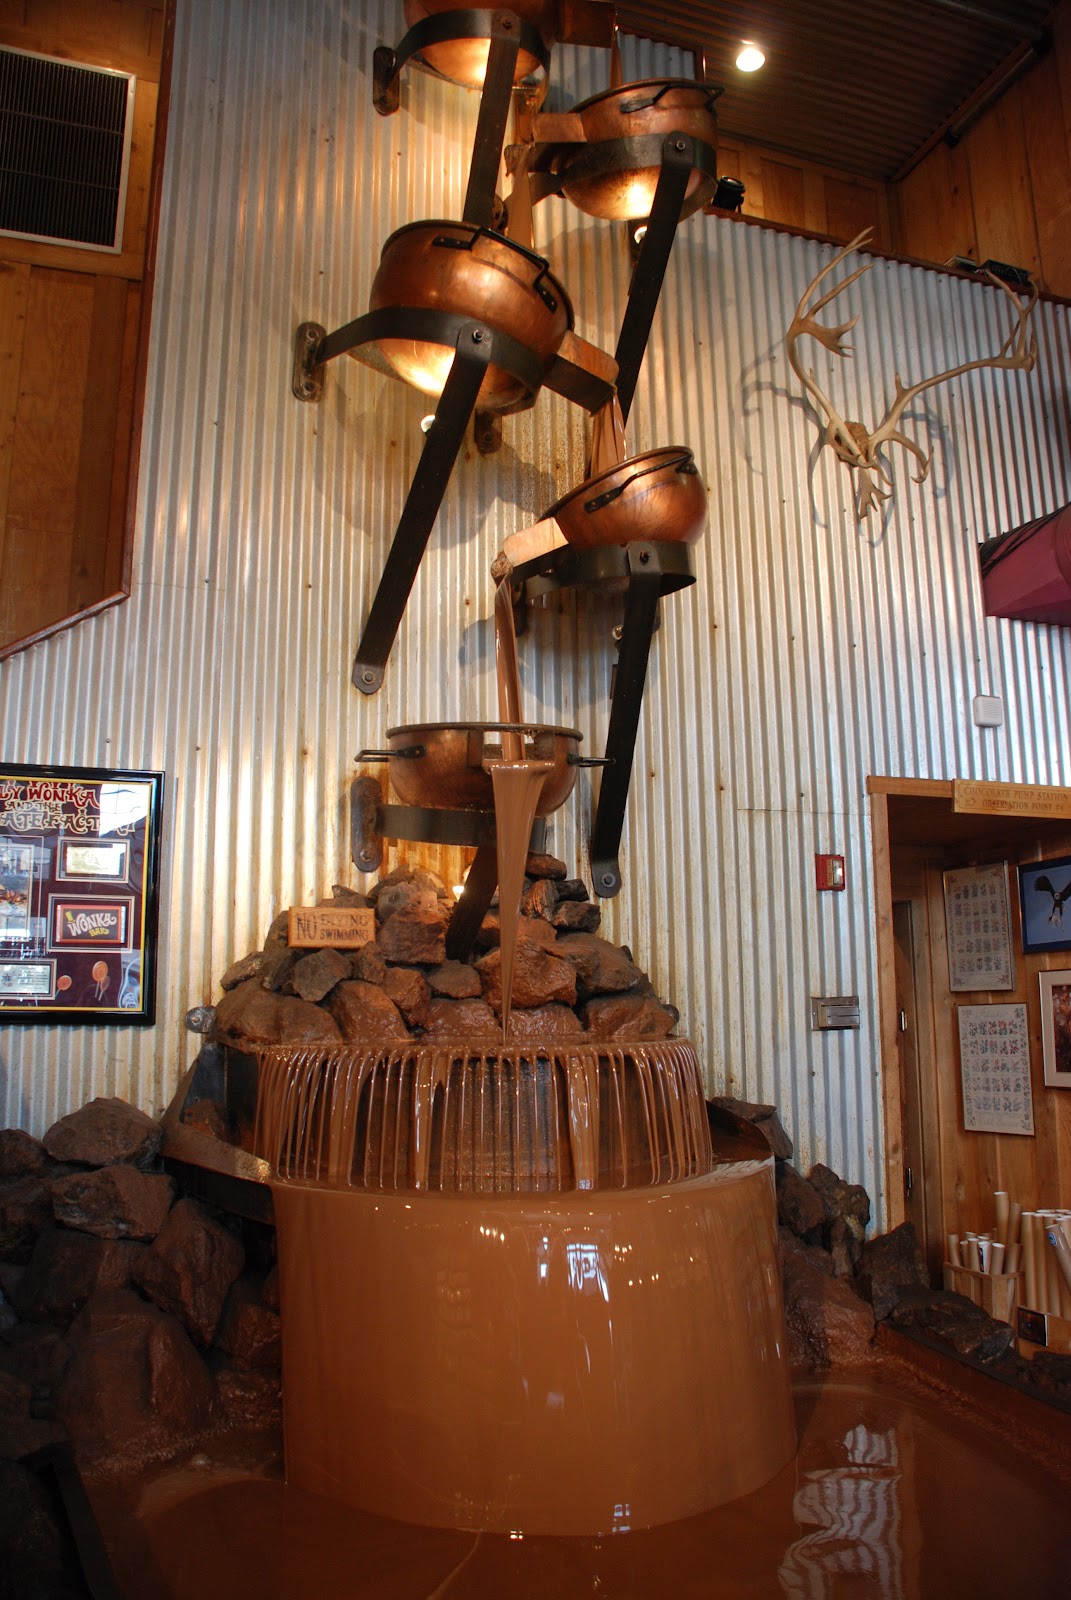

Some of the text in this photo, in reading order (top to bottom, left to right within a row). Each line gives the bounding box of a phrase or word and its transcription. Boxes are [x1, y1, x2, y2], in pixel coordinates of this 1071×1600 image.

[26, 782, 100, 809] WONKA
[963, 786, 1068, 802] CHOCOLATE PUMP STATION
[5, 801, 62, 814] AND THE
[982, 799, 1029, 810] OBSERVATION
[1032, 802, 1052, 811] POINT
[67, 913, 117, 937] WONKA
[88, 927, 110, 937] BAR
[296, 912, 318, 940] NO
[320, 928, 369, 941] SWIMMING
